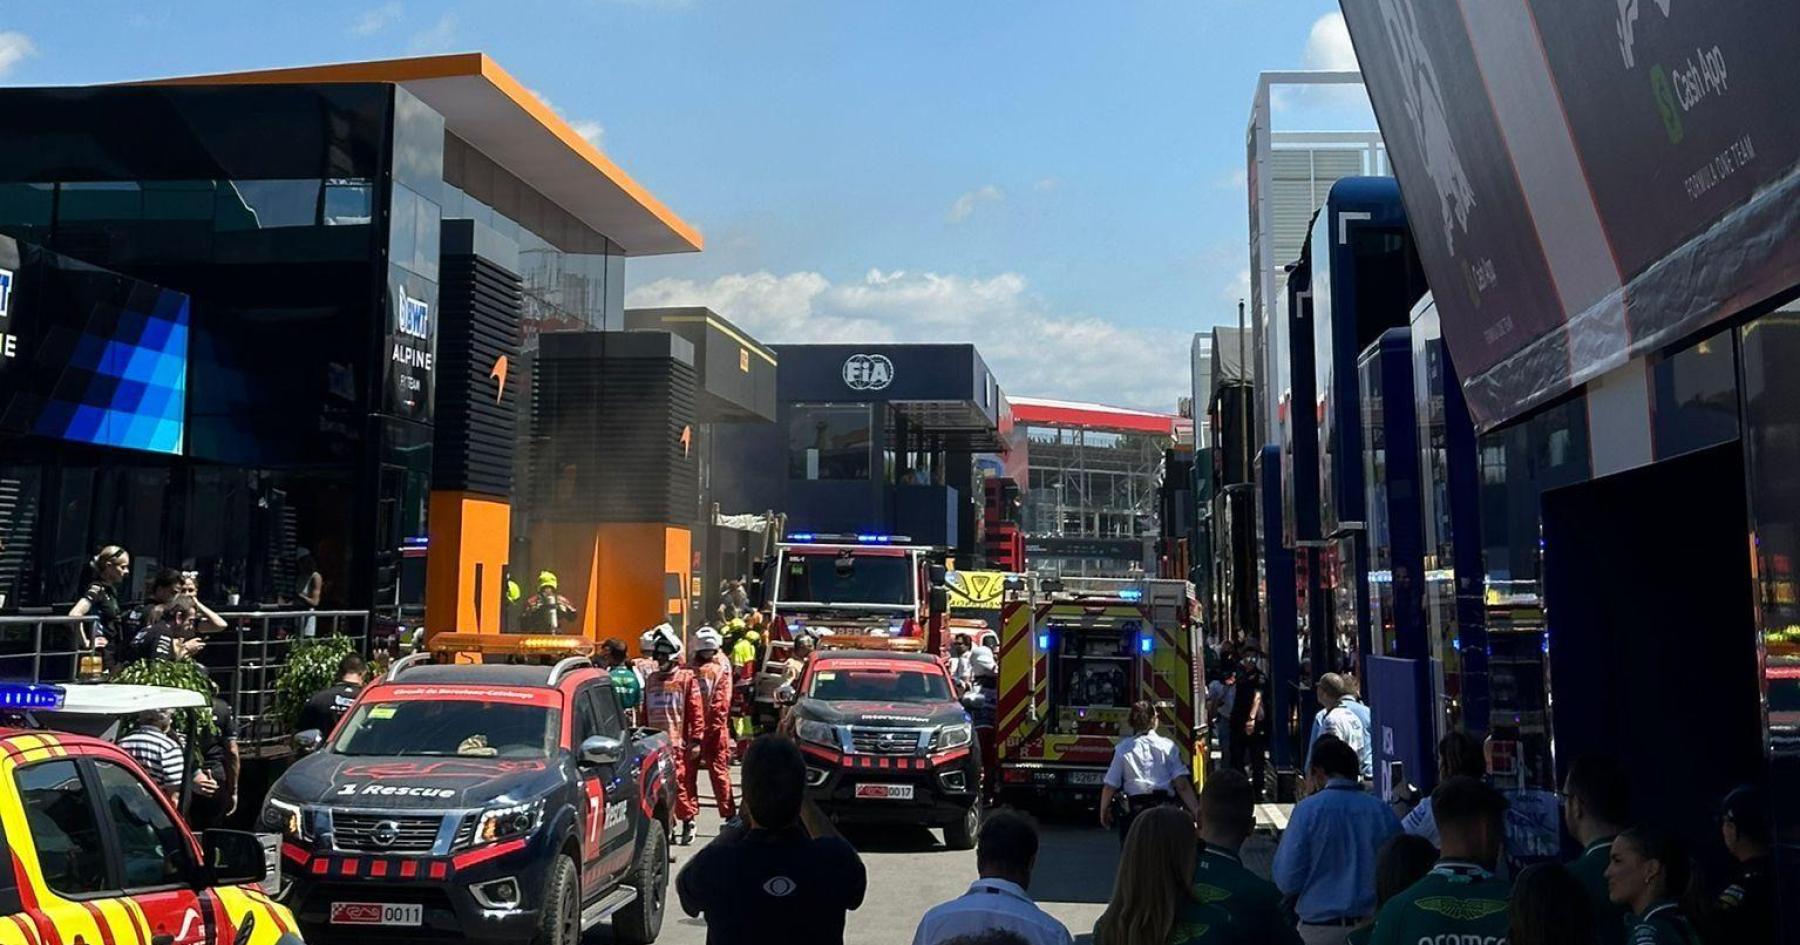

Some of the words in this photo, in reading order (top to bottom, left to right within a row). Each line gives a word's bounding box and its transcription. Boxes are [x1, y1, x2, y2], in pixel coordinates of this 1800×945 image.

[1672, 57, 1705, 112] Cash
[1697, 45, 1728, 96] App
[1685, 163, 1720, 202] FORMULA
[1715, 149, 1734, 180] ONE
[1731, 133, 1756, 167] TEAM
[392, 343, 432, 371] ALPINE
[337, 784, 356, 796] 1
[361, 785, 456, 799] Rescue
[888, 787, 912, 797] 0017
[590, 796, 599, 842] 7
[385, 907, 420, 922] 0011
